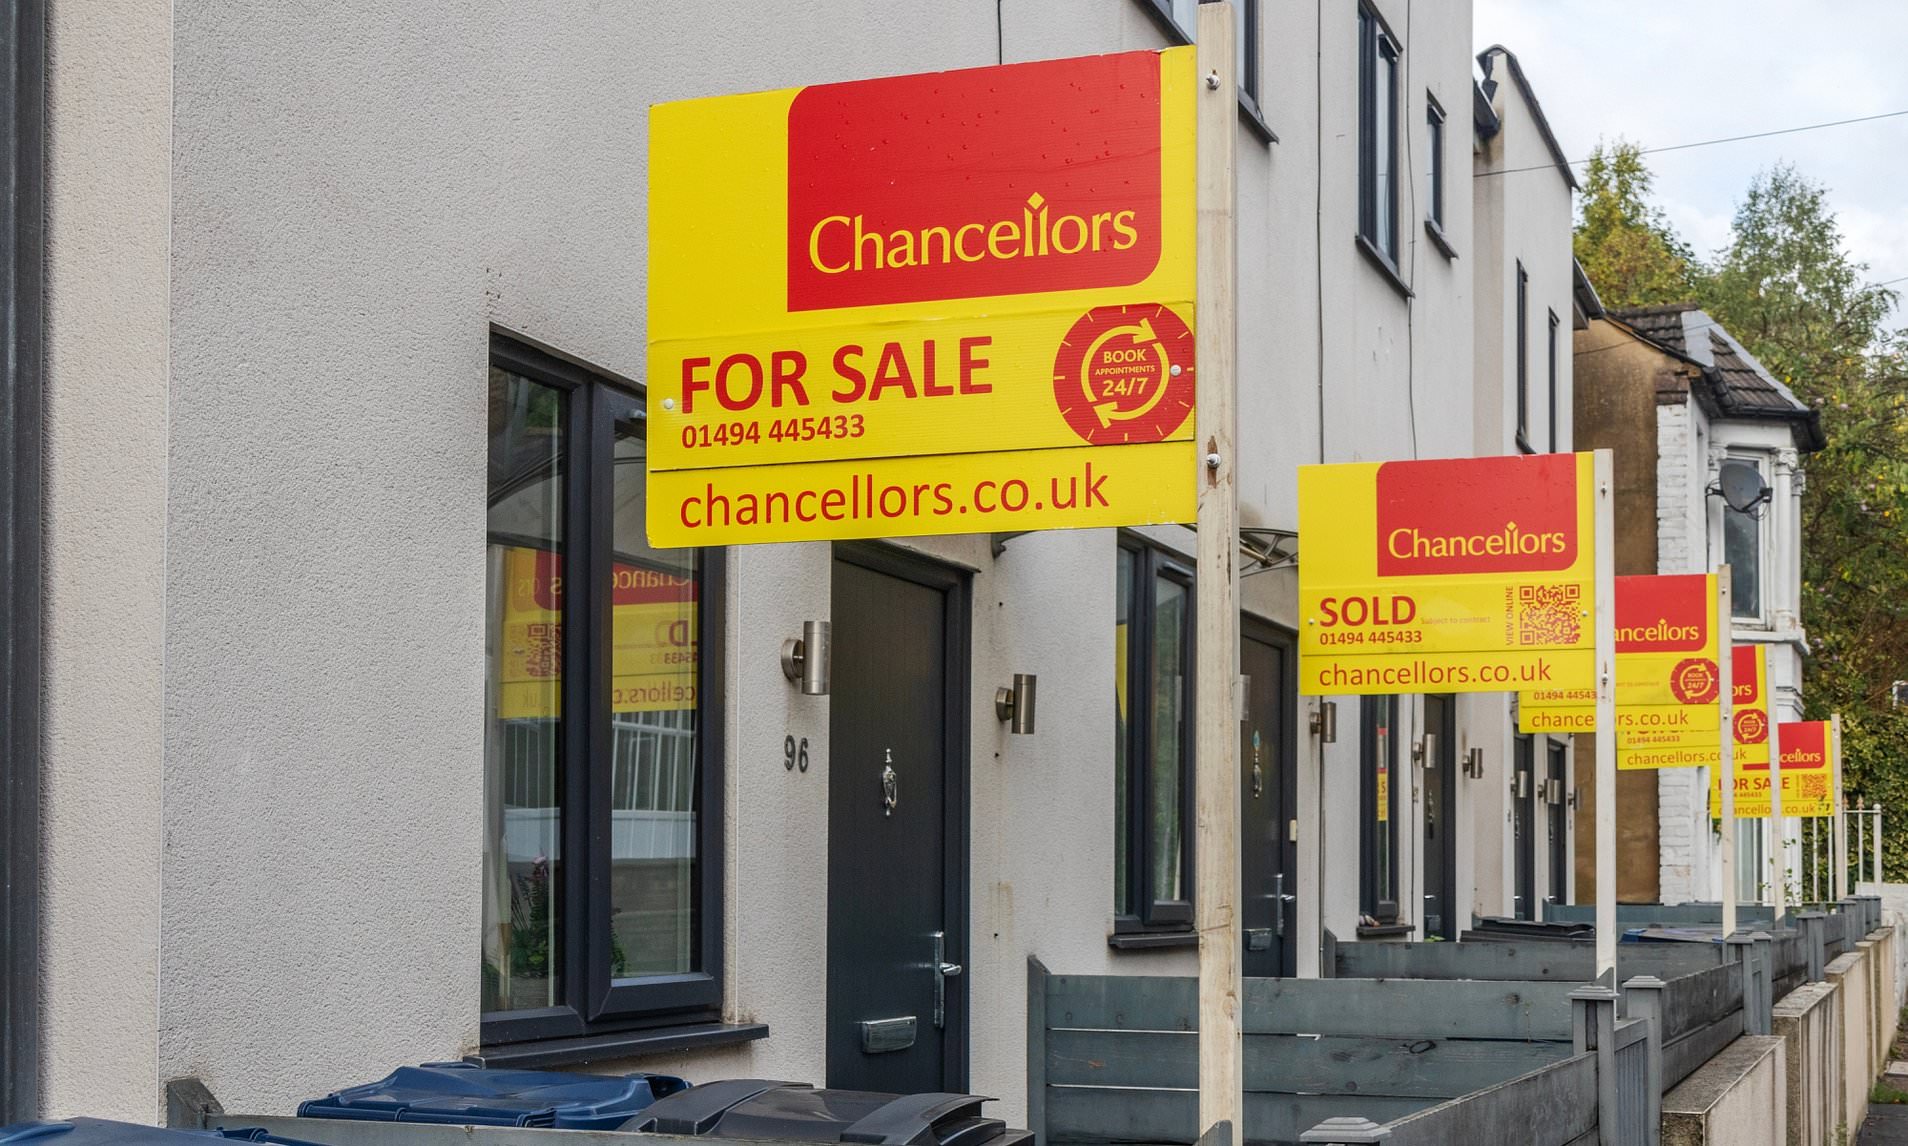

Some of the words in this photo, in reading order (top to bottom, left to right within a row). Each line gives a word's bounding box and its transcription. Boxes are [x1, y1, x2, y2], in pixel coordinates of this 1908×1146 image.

[808, 192, 1138, 274] Chancellors
[1103, 348, 1147, 364] BOOK
[680, 350, 811, 414] FOR
[831, 335, 993, 404] SALE
[1094, 364, 1156, 376] APPOINTMENTS
[1102, 377, 1149, 397] 24/7
[681, 421, 761, 449] 01494
[768, 414, 865, 443] 445433
[679, 462, 1110, 529] chancellors.co.uk
[1388, 521, 1566, 559] Chancellors
[1319, 595, 1416, 628] SOLD
[1505, 585, 1514, 621] ONLINE
[1319, 632, 1364, 646] 01494
[1368, 630, 1423, 645] 445433
[1615, 618, 1699, 642] ncellors
[1319, 657, 1552, 687] chancellors.co.uk
[1533, 691, 1564, 701] 01494
[1566, 690, 1598, 701] 44543
[1531, 708, 1689, 728] chancers.co.uk
[783, 734, 809, 774] 96
[1779, 748, 1822, 763] cellors
[1753, 776, 1790, 791] SAE
